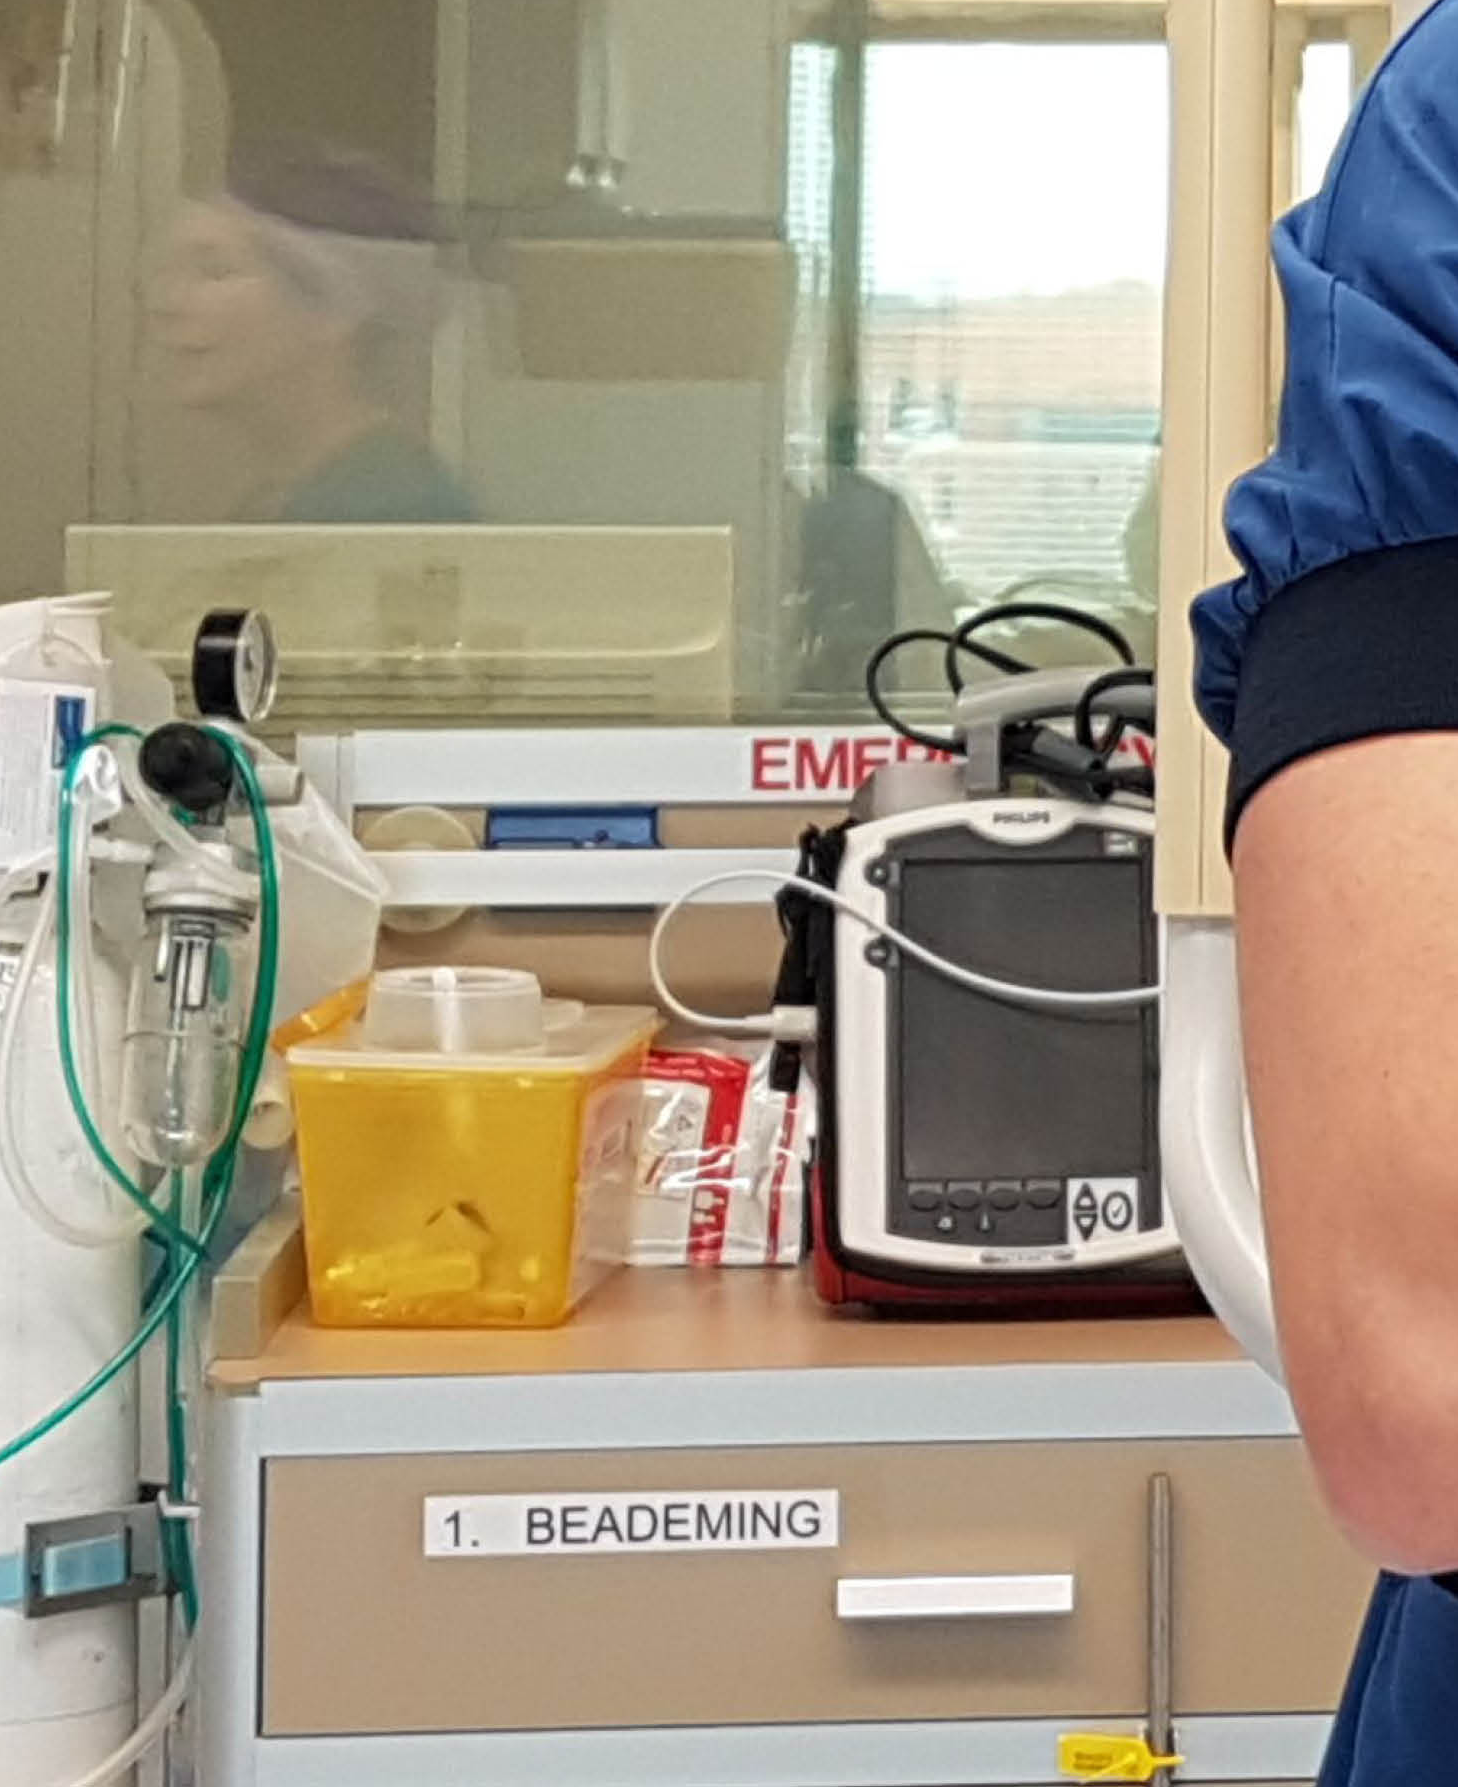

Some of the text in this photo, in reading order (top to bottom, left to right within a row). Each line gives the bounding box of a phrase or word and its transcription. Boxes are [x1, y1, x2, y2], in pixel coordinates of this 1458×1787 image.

[992, 810, 1051, 825] PHILIPS
[443, 1499, 822, 1548] 1. BEADEMING
